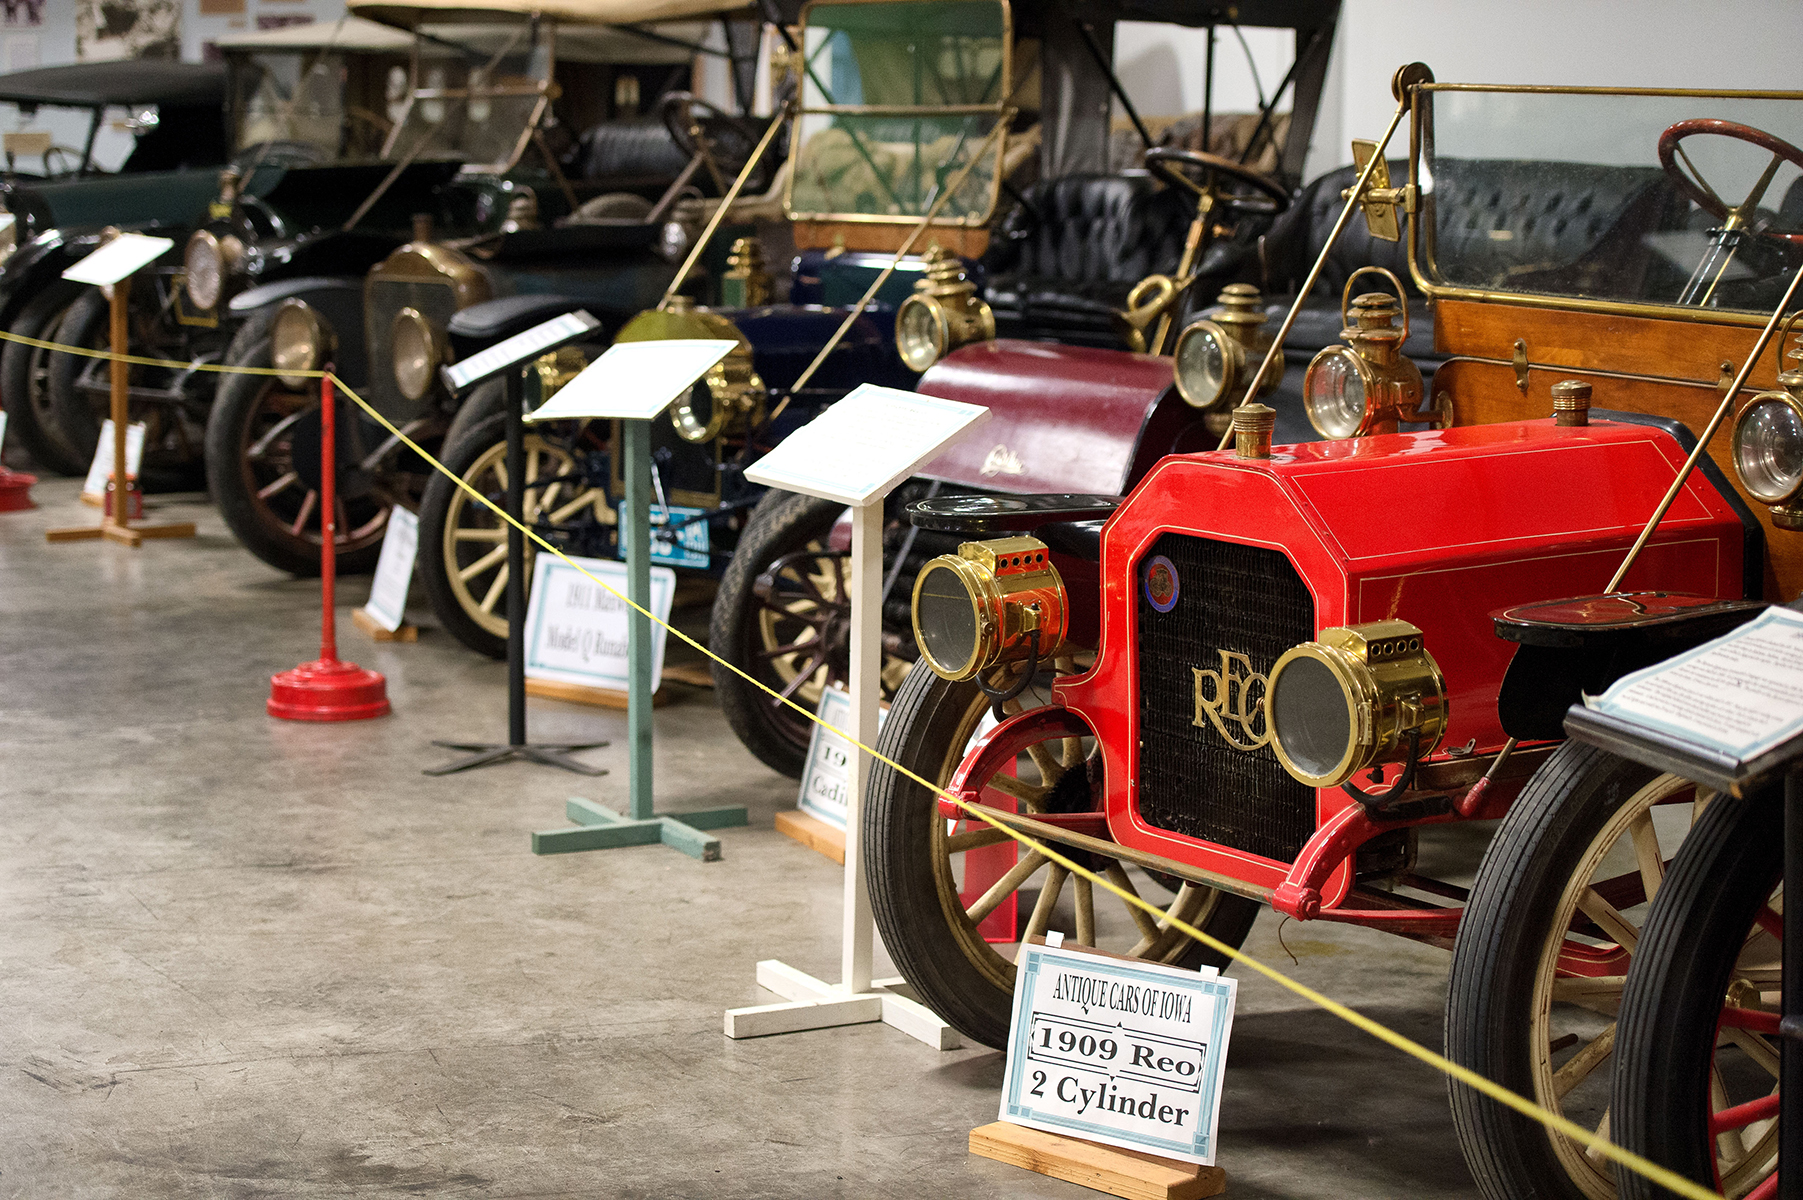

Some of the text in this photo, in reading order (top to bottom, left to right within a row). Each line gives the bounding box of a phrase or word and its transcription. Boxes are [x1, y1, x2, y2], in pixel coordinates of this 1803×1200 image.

[546, 624, 581, 653] Model
[1192, 648, 1269, 751] REO
[823, 746, 847, 768] 19
[1053, 972, 1193, 1023] ANTIQUE CARS OF IOWA
[1039, 1027, 1196, 1077] 1909 Reo
[1030, 1070, 1190, 1127] 2 Cylinder
